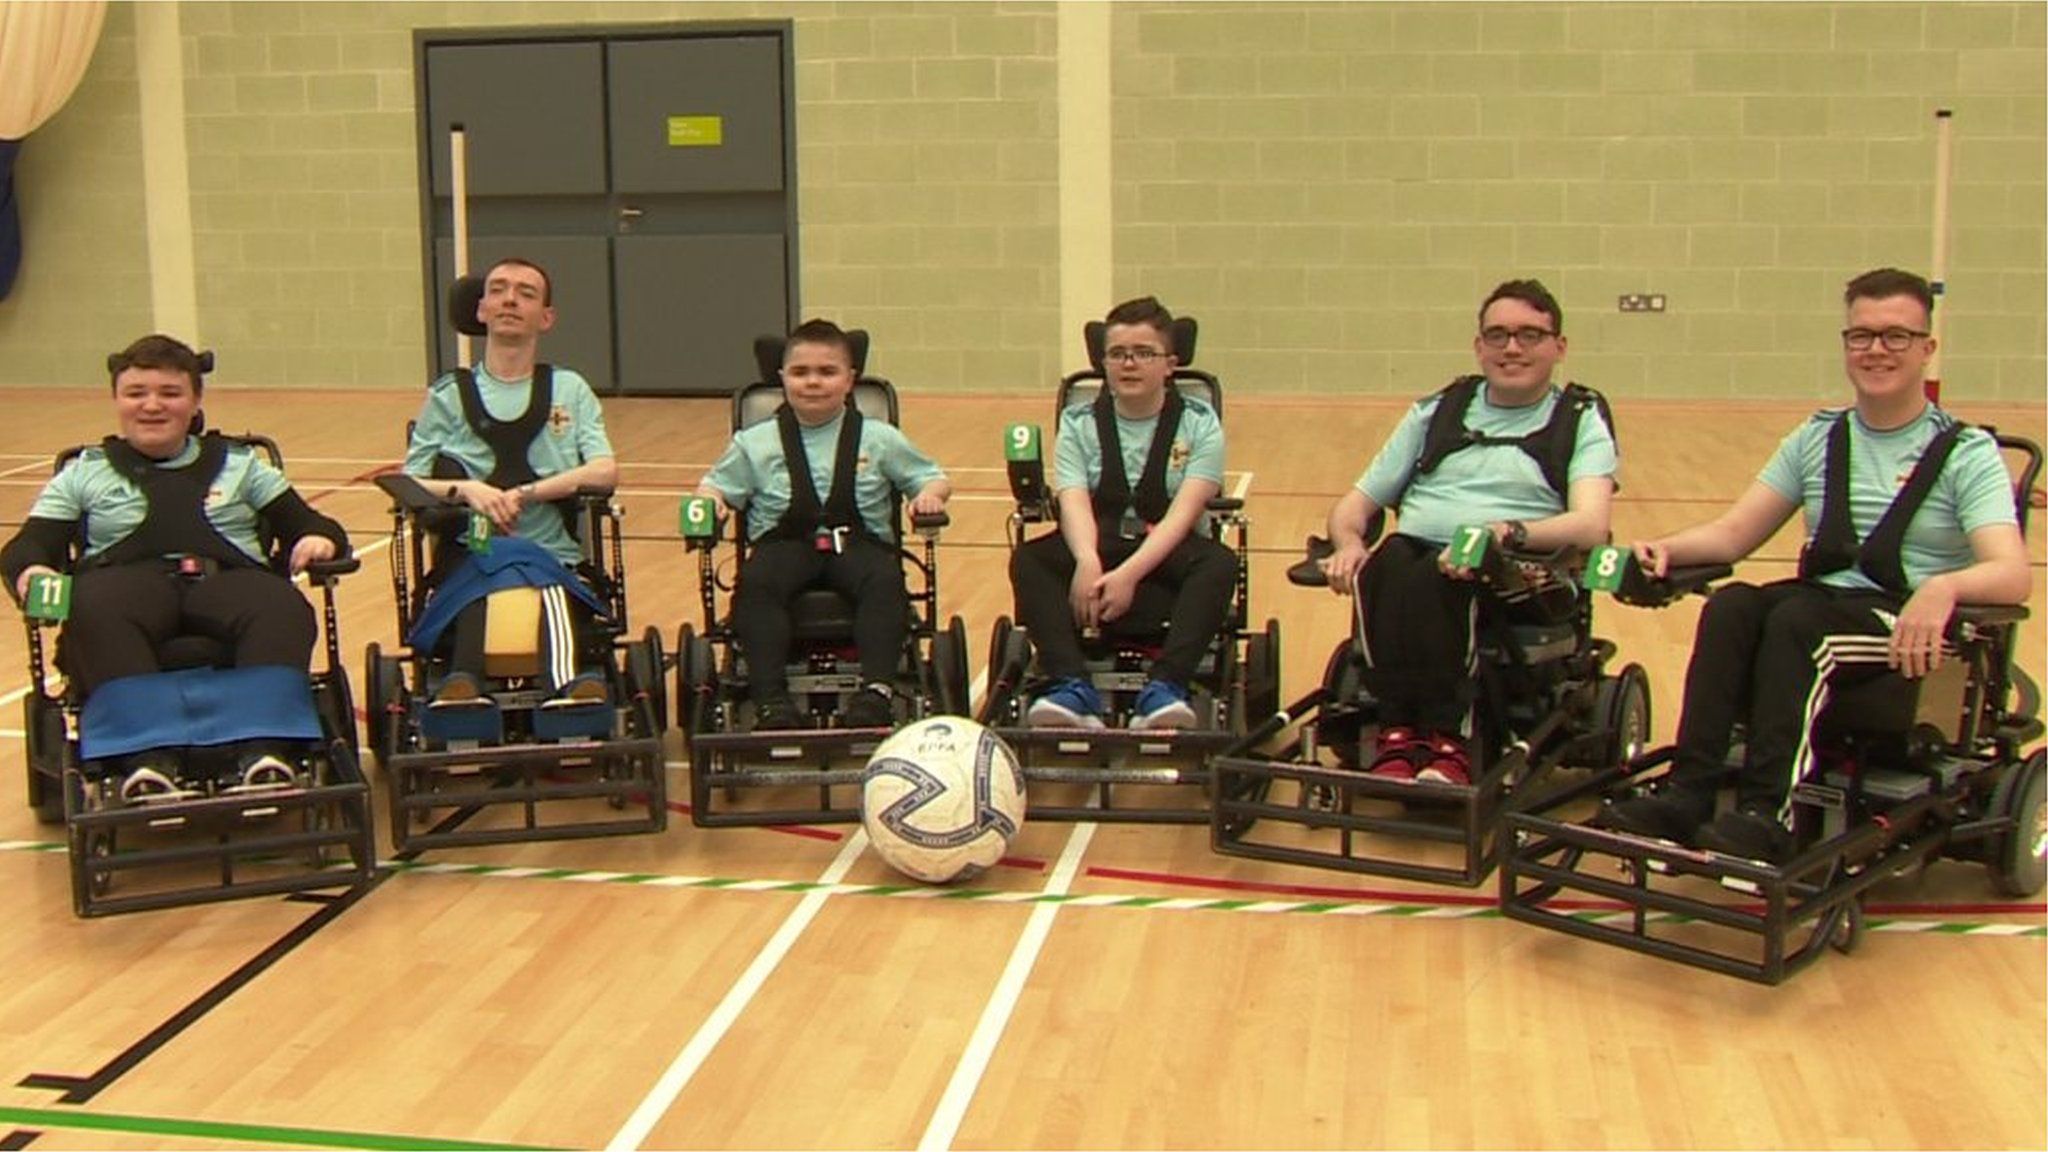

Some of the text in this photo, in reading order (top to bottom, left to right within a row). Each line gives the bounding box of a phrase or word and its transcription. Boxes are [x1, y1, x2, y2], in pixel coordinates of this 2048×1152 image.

[1012, 425, 1030, 449] 9
[687, 499, 704, 523] 6
[472, 514, 488, 541] 10
[1462, 528, 1482, 554] 7
[1596, 548, 1619, 577] 8
[40, 577, 63, 605] 11
